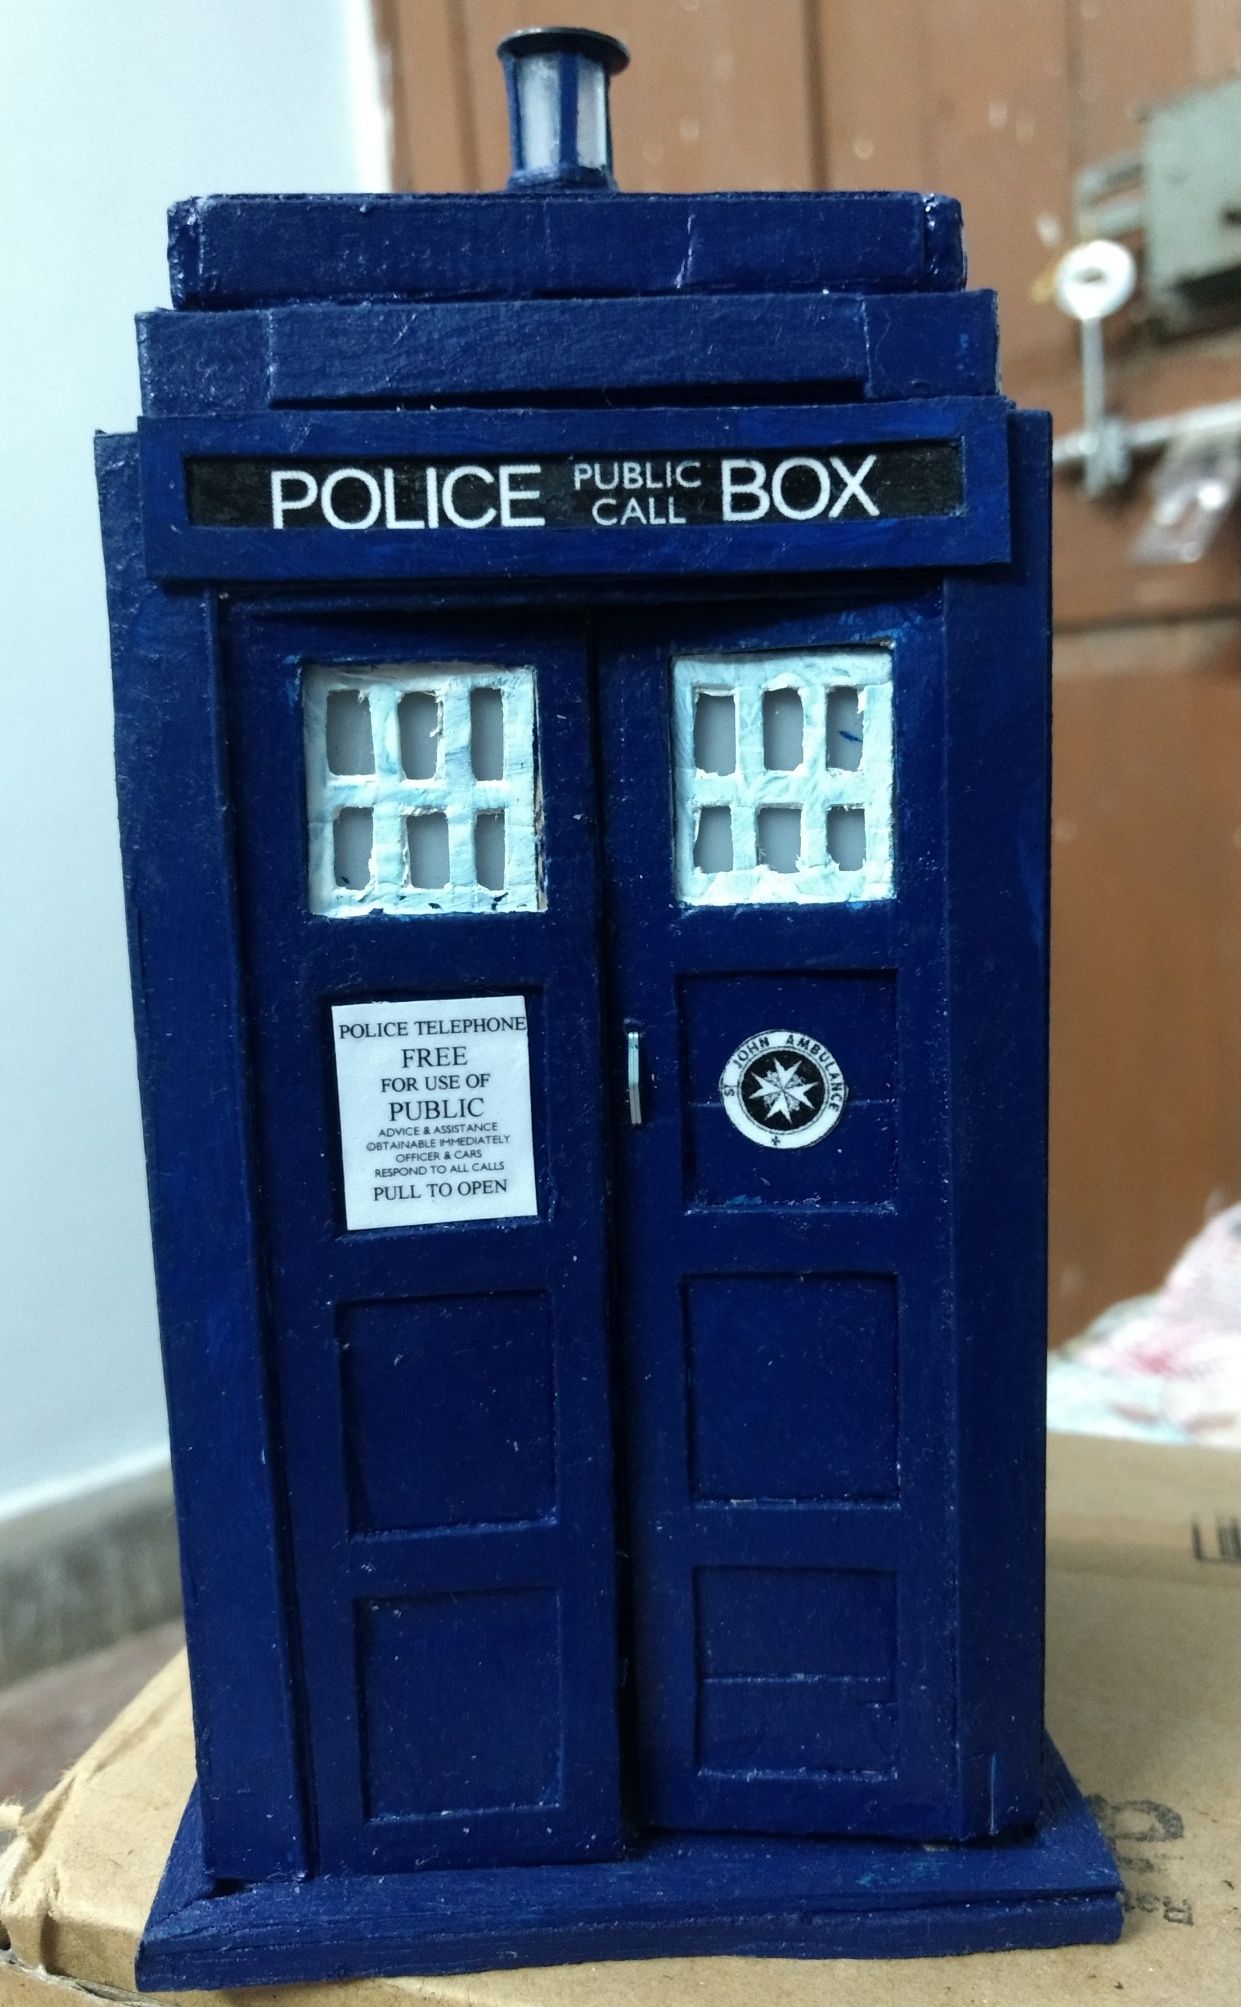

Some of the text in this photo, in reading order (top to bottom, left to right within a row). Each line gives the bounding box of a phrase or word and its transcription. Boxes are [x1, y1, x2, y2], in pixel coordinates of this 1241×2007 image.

[572, 461, 703, 492] PUBLIC
[269, 465, 546, 531] POLICE
[720, 453, 880, 523] BOX
[591, 498, 687, 526] CALL
[339, 1016, 527, 1039] POLICE TELEPHONE
[400, 1046, 468, 1068] FREE
[381, 1073, 491, 1092] FOR USE OF
[733, 1037, 770, 1069] JOHN
[785, 1034, 843, 1112] AMBULANCE
[388, 1098, 485, 1121] PUBLIC
[378, 1122, 498, 1138] ADVICE & ASSISTANCE
[366, 1135, 511, 1151] OBTAINABLE IMMEDIATELY
[395, 1150, 482, 1163] OFFICER & CARS
[374, 1162, 505, 1178] RESPOND TO ALL CALLS
[373, 1179, 507, 1201] PULL TO OPEN
